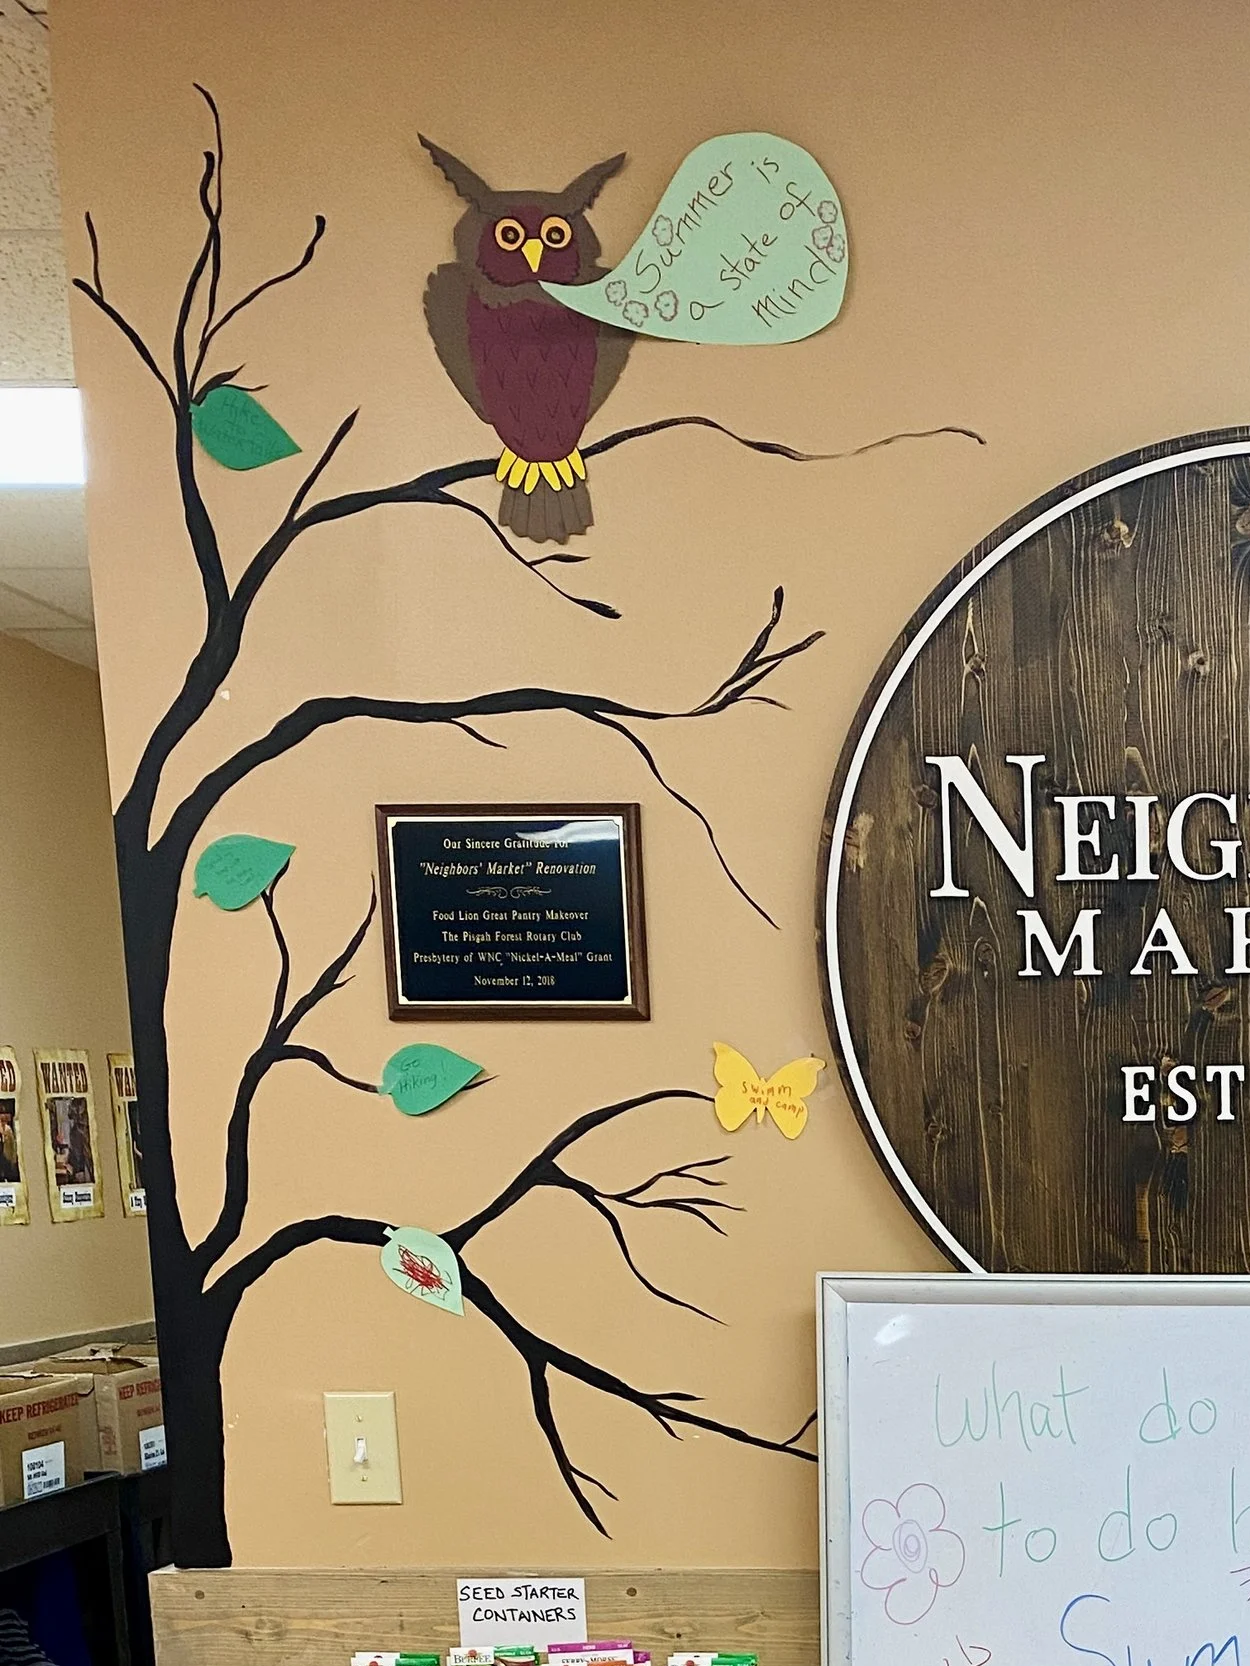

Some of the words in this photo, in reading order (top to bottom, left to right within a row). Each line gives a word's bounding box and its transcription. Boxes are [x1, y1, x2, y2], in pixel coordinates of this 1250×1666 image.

[635, 160, 734, 294] Summer
[749, 156, 780, 184] is
[689, 300, 724, 321] a
[719, 232, 778, 291] state
[779, 181, 816, 221] of
[443, 838, 462, 850] Our
[465, 838, 500, 850] Sincere
[536, 861, 597, 874] Renovation
[432, 909, 454, 922] Food
[458, 909, 479, 922] Lion
[482, 909, 508, 921] Great
[512, 909, 542, 923] Pantry
[546, 909, 589, 921] Makeover
[441, 931, 458, 943] The
[462, 931, 491, 945] Pisgah
[495, 931, 522, 942] Forest
[526, 931, 557, 944] Rotary
[560, 930, 582, 942] Club
[413, 952, 460, 965] Presbytery
[463, 951, 474, 963] of
[586, 952, 613, 963] Grant
[473, 975, 518, 987] November
[522, 975, 535, 988] 12,
[537, 975, 556, 987] 2018
[399, 1056, 422, 1073] Go
[41, 1062, 89, 1094] WANTED
[775, 1100, 805, 1119] camp
[934, 1361, 1090, 1450] What
[1137, 1368, 1216, 1445] do
[981, 1481, 1057, 1578] to
[1096, 1465, 1178, 1562] do
[459, 1585, 506, 1602] SEED
[511, 1584, 580, 1602] STARTER
[472, 1606, 578, 1624] CONTAINERS
